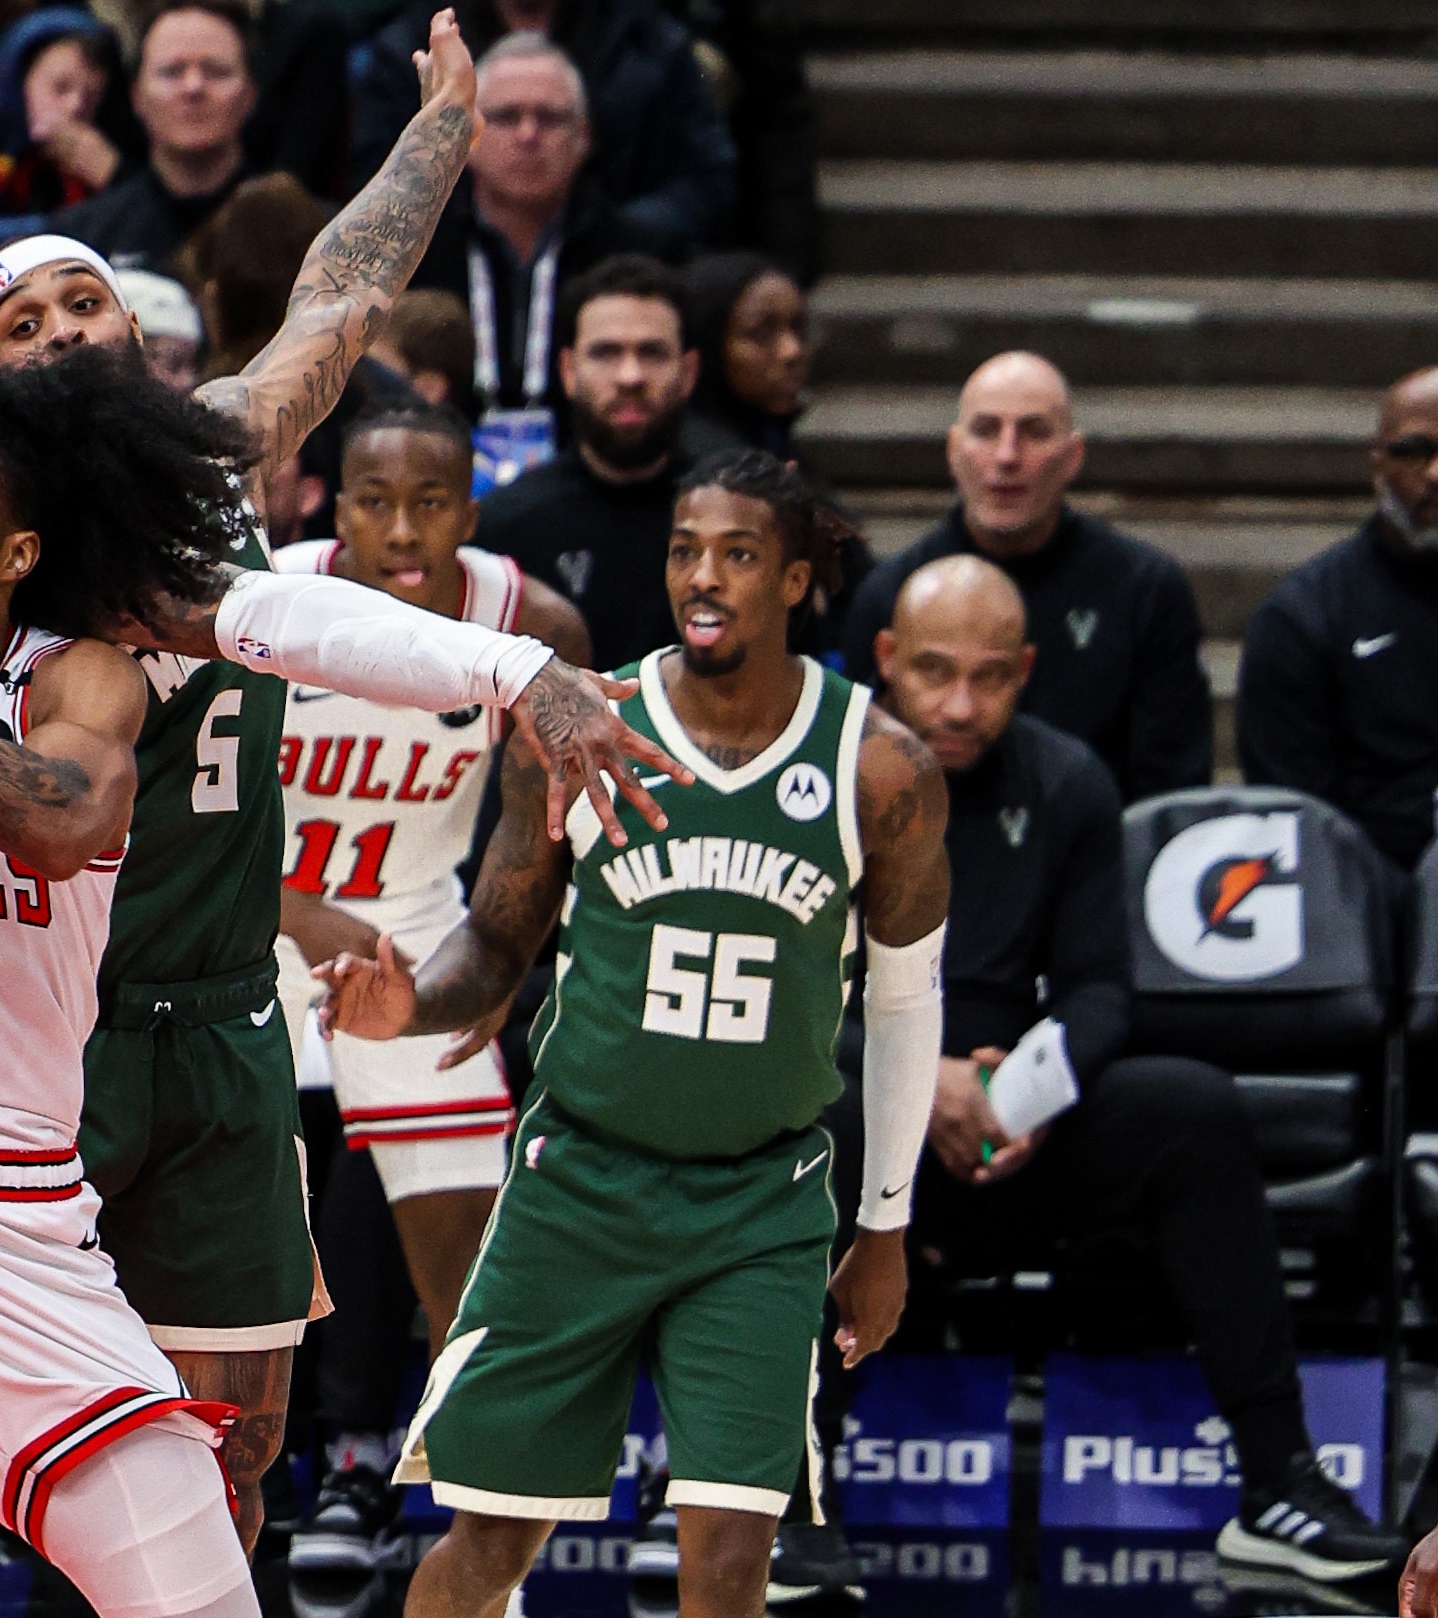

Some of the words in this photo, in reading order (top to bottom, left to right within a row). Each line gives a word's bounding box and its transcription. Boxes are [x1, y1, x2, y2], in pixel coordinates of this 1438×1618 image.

[191, 688, 244, 814] 5
[278, 734, 481, 804] BULLS
[281, 818, 396, 899] 11
[599, 836, 837, 926] MILWAUKEE
[641, 923, 777, 1043] 55
